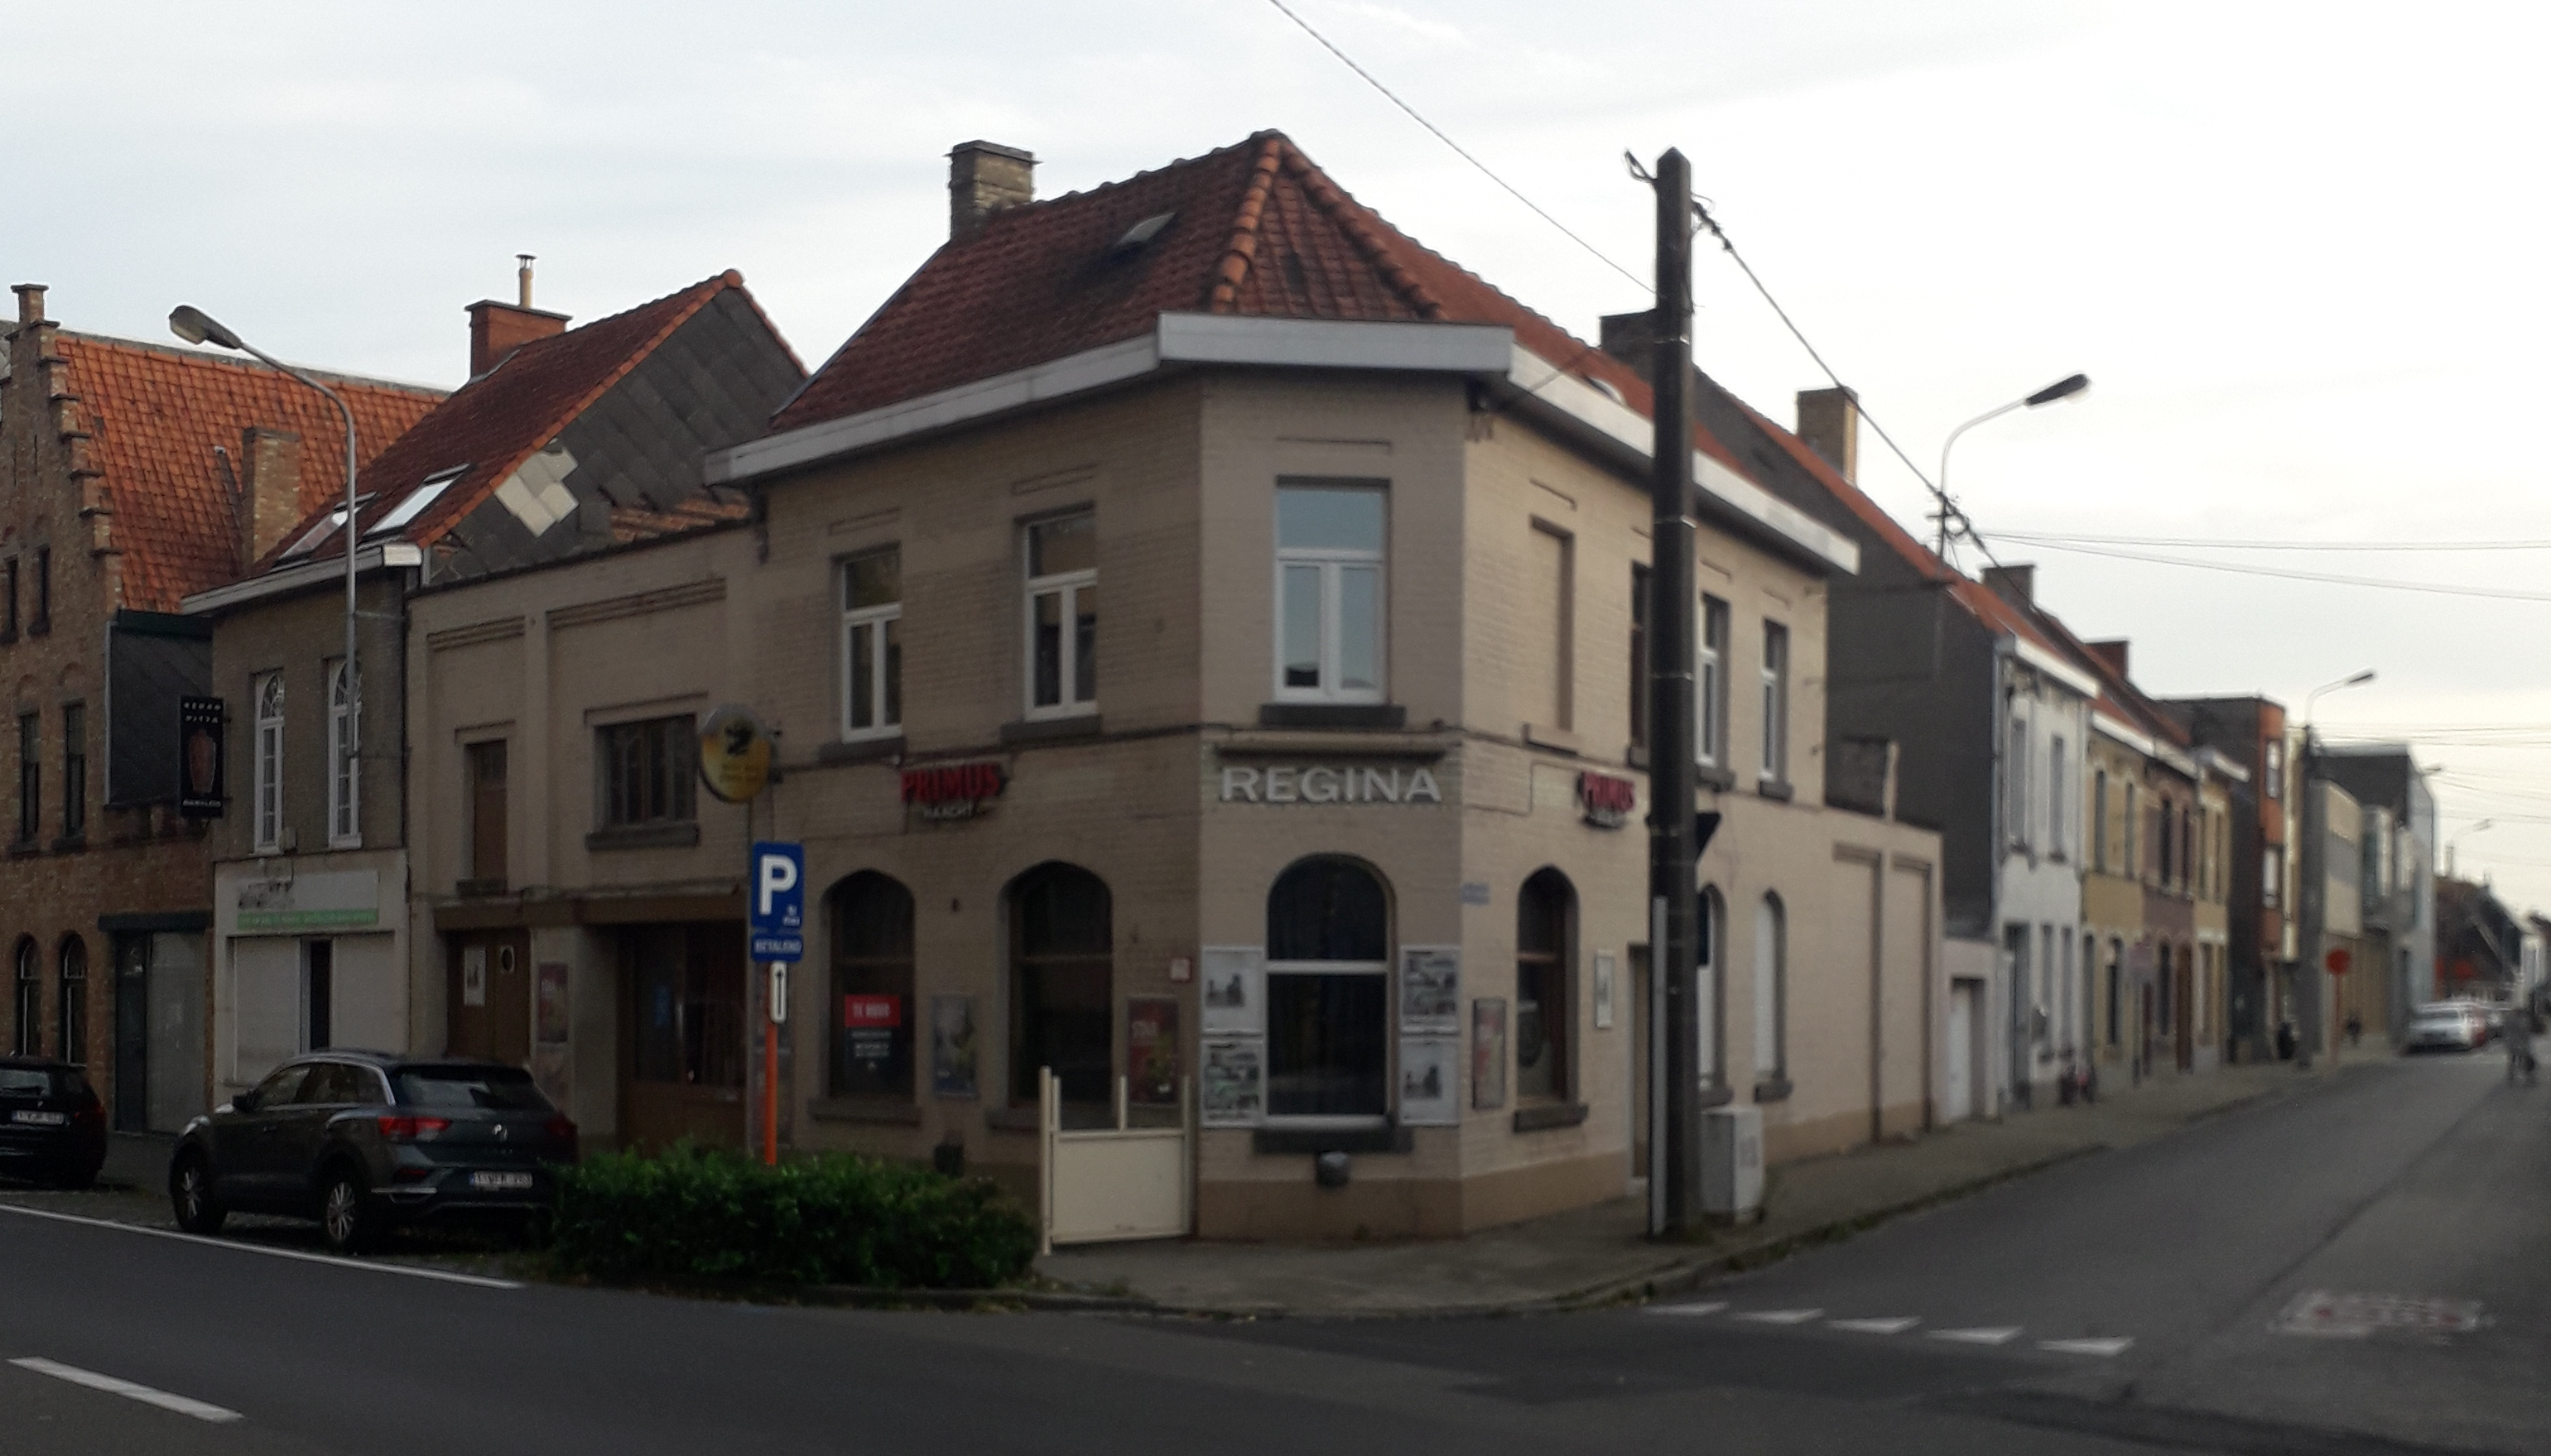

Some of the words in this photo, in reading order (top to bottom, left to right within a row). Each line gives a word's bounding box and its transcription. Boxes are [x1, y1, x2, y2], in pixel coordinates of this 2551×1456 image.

[901, 762, 1000, 803] PRIMUS
[1220, 766, 1442, 803] REGINA
[758, 853, 798, 915] P
